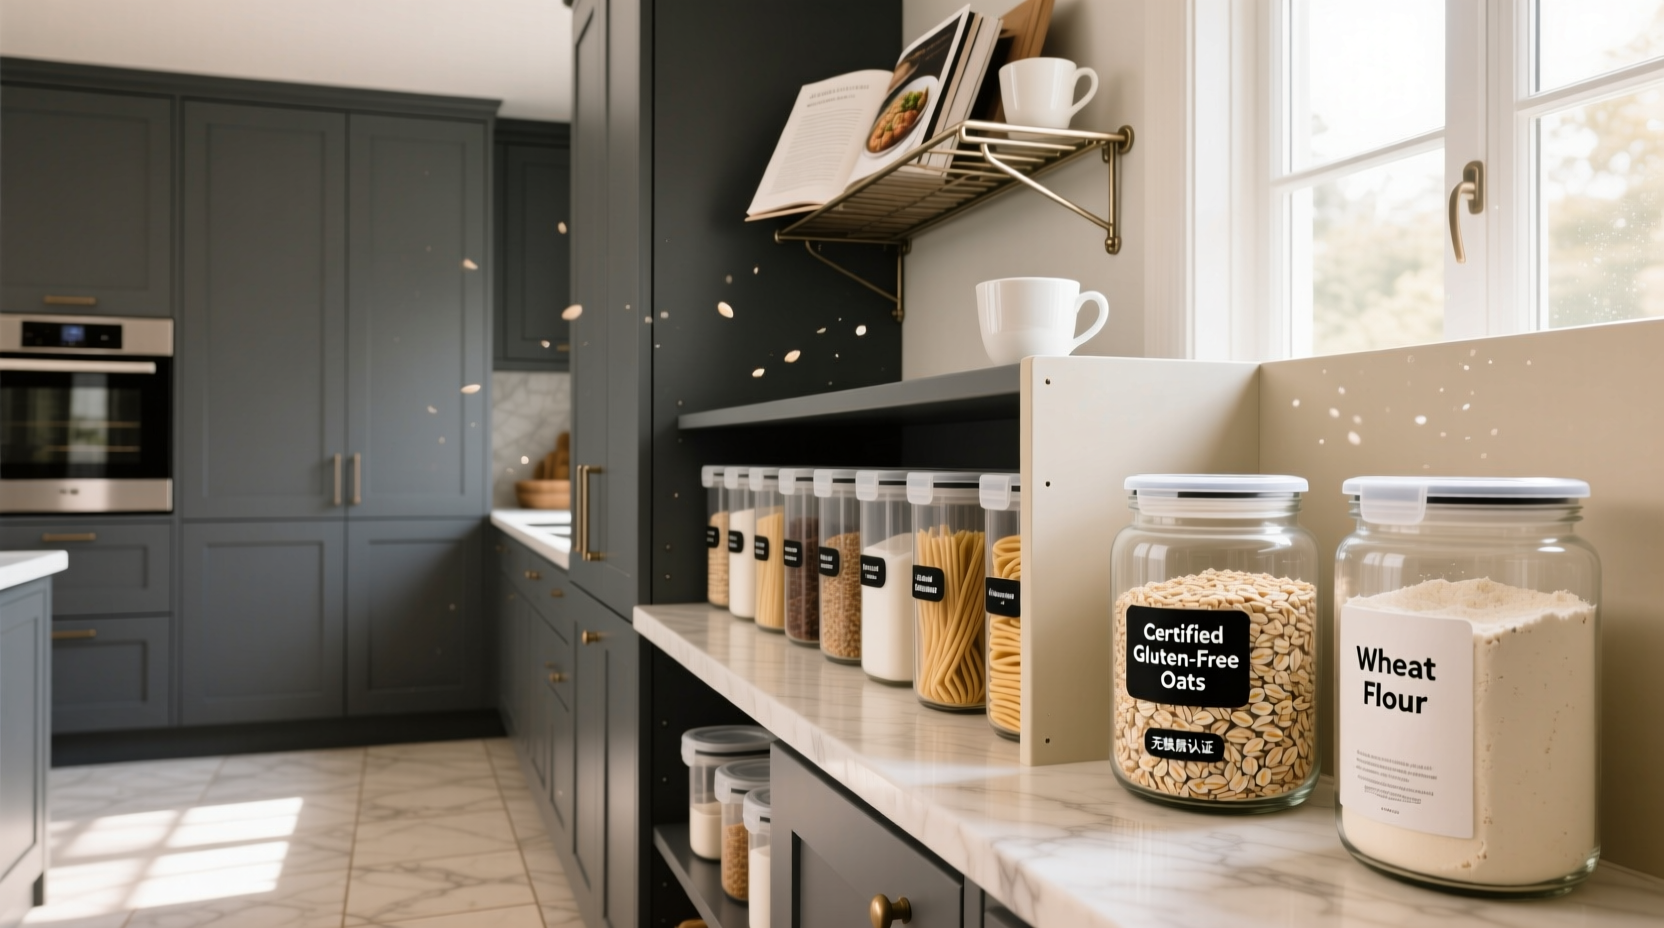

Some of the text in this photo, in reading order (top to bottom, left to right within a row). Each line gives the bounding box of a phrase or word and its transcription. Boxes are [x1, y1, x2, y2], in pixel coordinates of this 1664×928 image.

[1144, 622, 1224, 644] Certified
[1133, 644, 1239, 669] Gluten-Free
[1356, 645, 1436, 681] Wheat
[1160, 670, 1206, 691] Oats
[1364, 680, 1428, 714] Flour
